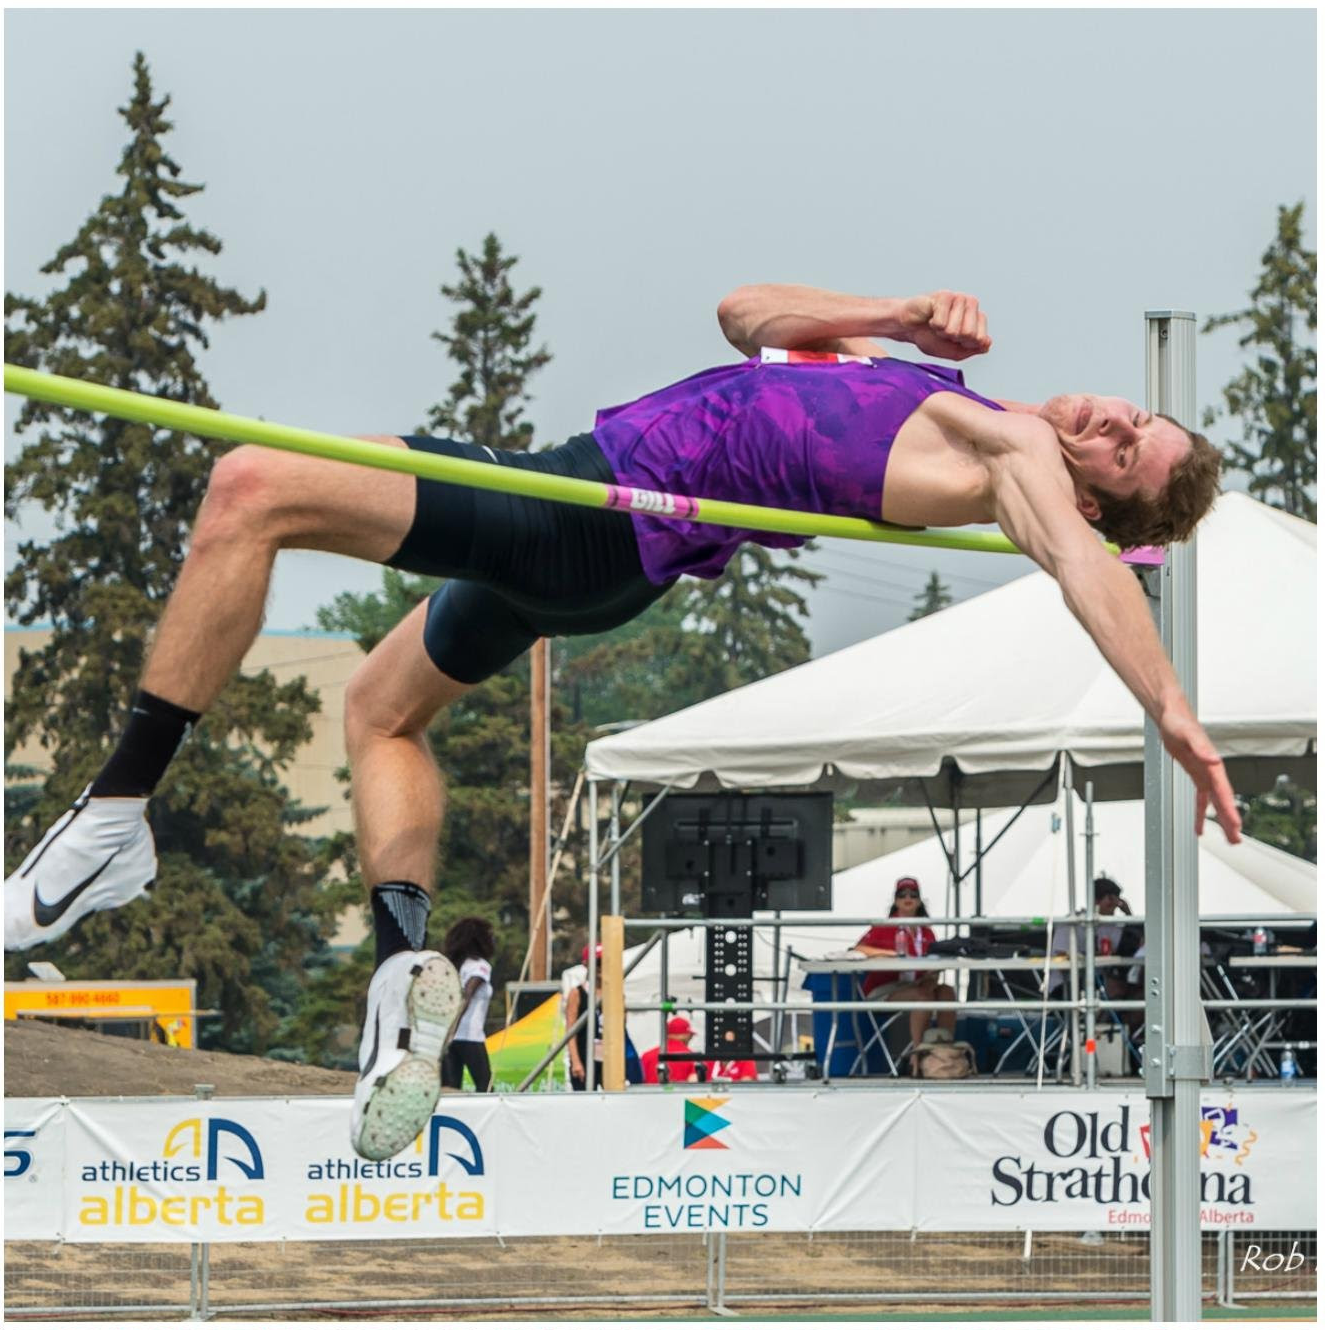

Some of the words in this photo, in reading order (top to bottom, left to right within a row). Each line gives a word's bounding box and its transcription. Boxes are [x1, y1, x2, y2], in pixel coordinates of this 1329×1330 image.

[1044, 1106, 1131, 1159] Old
[81, 1158, 201, 1182] athletics
[307, 1155, 423, 1180] athletics
[613, 1174, 802, 1200] EDMONTON
[991, 1156, 1255, 1206] Strathna
[78, 1186, 265, 1226] alberta
[304, 1183, 485, 1225] alberta
[644, 1204, 769, 1227] EVENTS
[1200, 1210, 1255, 1224] Alberta
